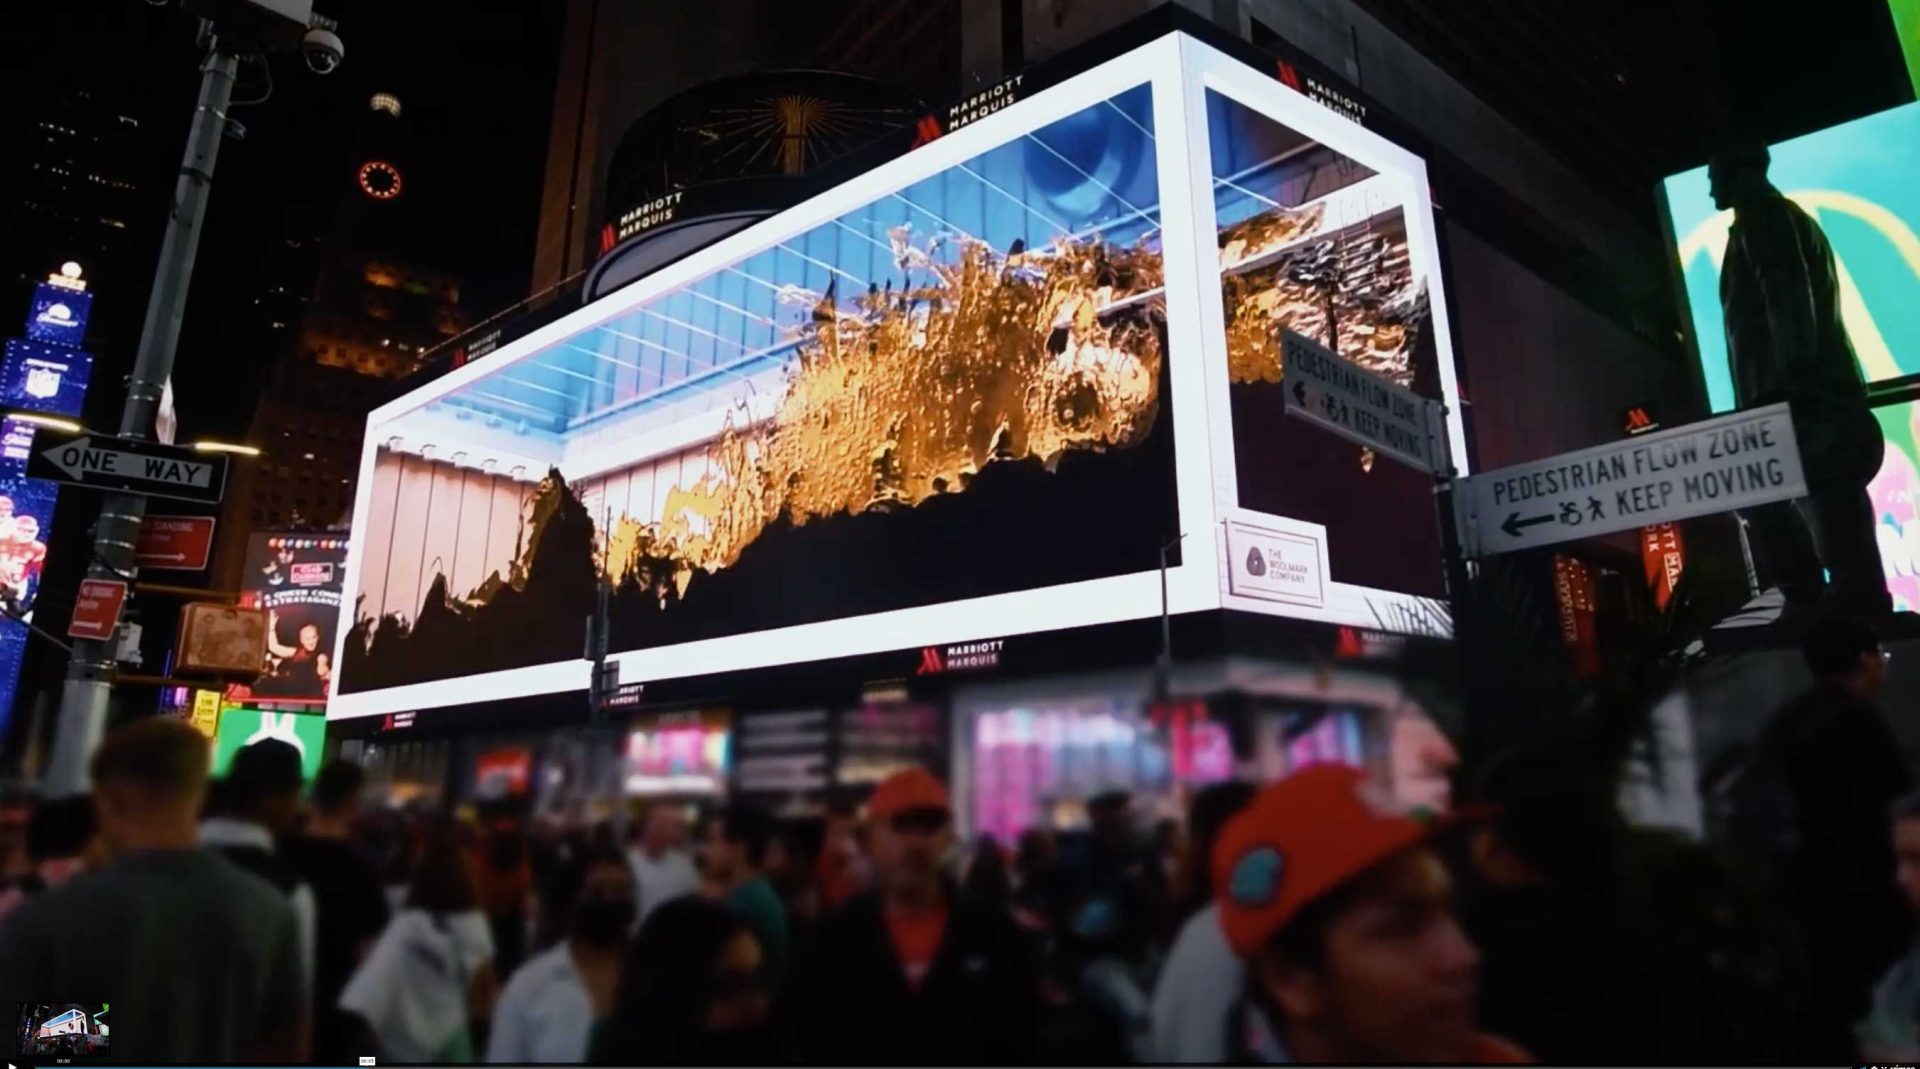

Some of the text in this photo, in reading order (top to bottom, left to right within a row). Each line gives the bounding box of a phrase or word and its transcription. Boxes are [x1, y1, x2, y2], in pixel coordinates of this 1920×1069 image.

[949, 93, 1015, 131] MARQUIS
[950, 75, 1024, 117] MARRIOTT
[1307, 78, 1366, 117] MARRIOTT
[618, 208, 673, 240] MARQUIS
[620, 191, 684, 227] MARRIOTT
[1287, 339, 1418, 426] PEDESTRIAN FLOW ZONE
[1354, 406, 1422, 458] KEEP MOVING
[62, 447, 201, 483] ONE WAY
[1493, 420, 1776, 506] PEDESTRIAN FLOW ZONE
[1616, 458, 1784, 515] KEEP MOVING
[1268, 547, 1282, 560] THE
[1269, 560, 1308, 574] WOOLMARK
[1269, 570, 1305, 584] COMPANY
[947, 640, 1004, 656] MARRIOTT
[947, 653, 998, 669] MARQUIS
